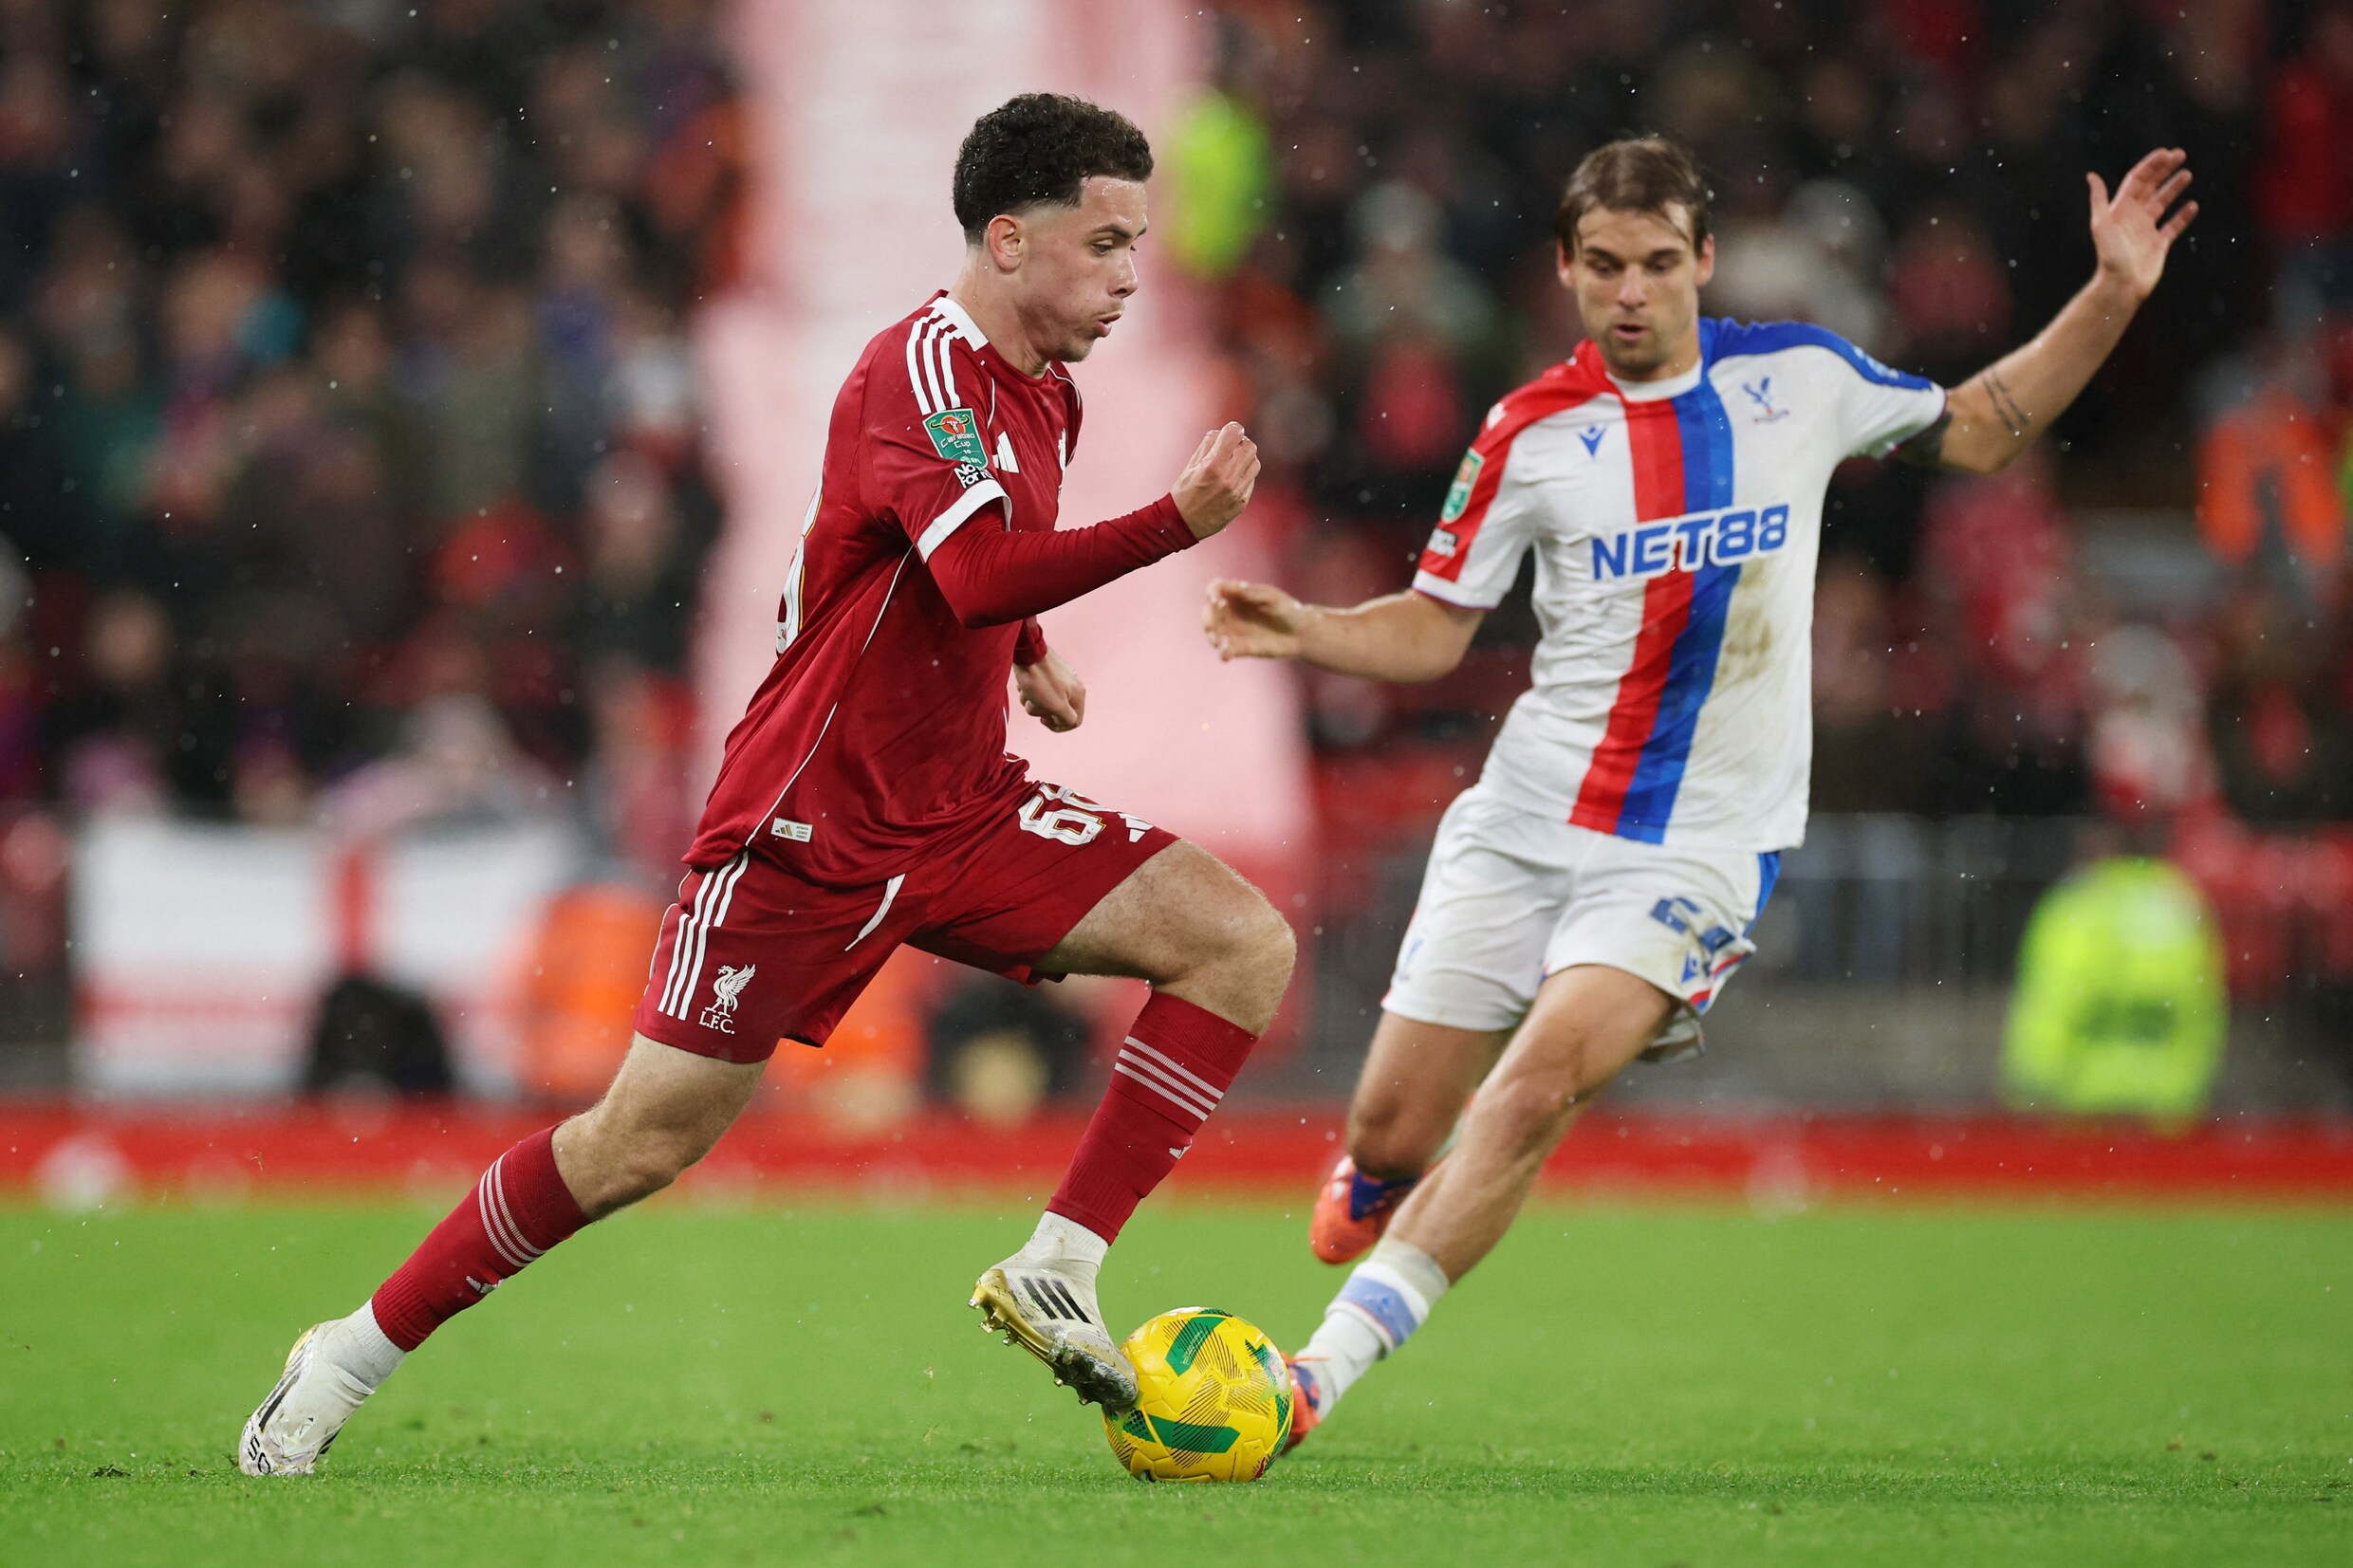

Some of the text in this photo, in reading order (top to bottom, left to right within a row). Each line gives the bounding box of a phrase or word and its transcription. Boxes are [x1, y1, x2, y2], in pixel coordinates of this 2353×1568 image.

[940, 433, 975, 448] Carabao
[954, 463, 976, 477] No
[1591, 503, 1789, 581] NET88
[698, 1010, 735, 1035] L.F.C.
